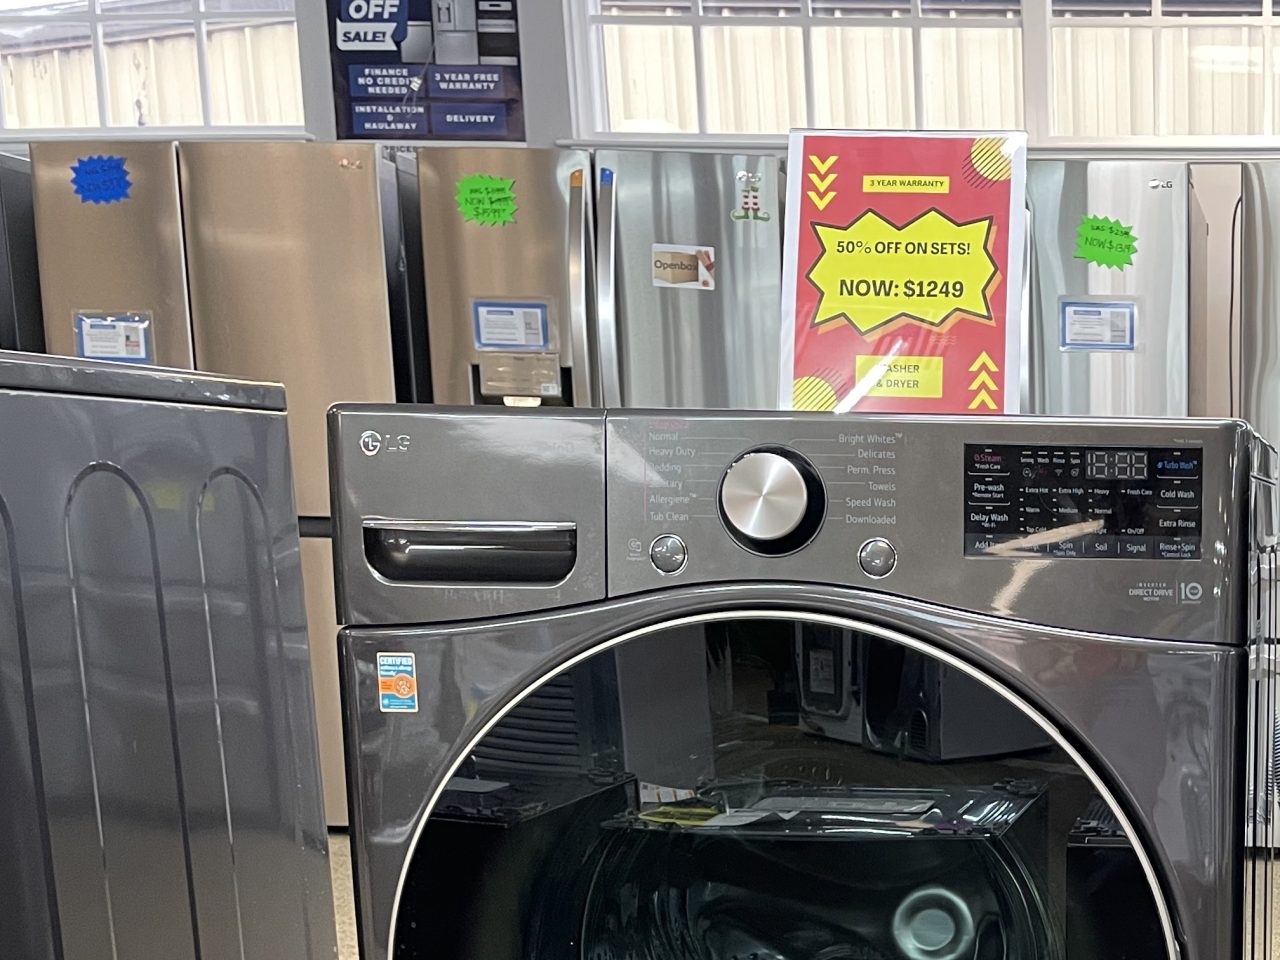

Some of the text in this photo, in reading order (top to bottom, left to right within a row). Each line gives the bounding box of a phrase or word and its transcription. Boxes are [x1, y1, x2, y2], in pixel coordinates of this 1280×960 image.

[348, 0, 400, 20] OFF
[342, 31, 386, 43] SALE!
[364, 68, 408, 76] FINANCE
[357, 77, 373, 85] NO
[434, 73, 500, 82] 3 YEAR FREE
[368, 86, 408, 95] NEEDED
[439, 82, 495, 91] WARRANTY
[355, 105, 425, 114] INSTALLATION
[446, 115, 496, 124] DELIVERY
[364, 122, 417, 131] HAULAWAY
[869, 180, 945, 188] 3 YEAR WARRANTY
[836, 240, 971, 256] 50% OFF ON SETS!
[654, 259, 698, 271] Openbox
[839, 278, 965, 300] NOW: $1249
[881, 364, 920, 373] ASHER
[886, 380, 920, 388] DRYER
[648, 431, 679, 441] Normal
[839, 433, 864, 446] Bright
[385, 435, 410, 452] LG
[648, 446, 696, 458] Heavy Duty
[858, 449, 896, 459] Delicates
[980, 455, 1002, 463] Steam
[847, 465, 896, 475] Perm. Press
[869, 481, 896, 491] Towels
[974, 483, 1004, 492] Pre-wash
[1072, 487, 1084, 495] High
[1160, 490, 1194, 498] Cold Wash
[846, 497, 896, 509] Speed Wash
[650, 511, 689, 521] Tub Clean
[846, 514, 896, 525] Downloaded
[971, 513, 1008, 523] Delay Wash
[1159, 519, 1196, 528] Extra Rinse
[1059, 542, 1073, 551] Spin
[1095, 543, 1108, 551] Soil
[1126, 544, 1146, 554] Signal
[1159, 543, 1196, 552] Rinse+Spin
[1129, 588, 1174, 596] DIRECT DRIVE
